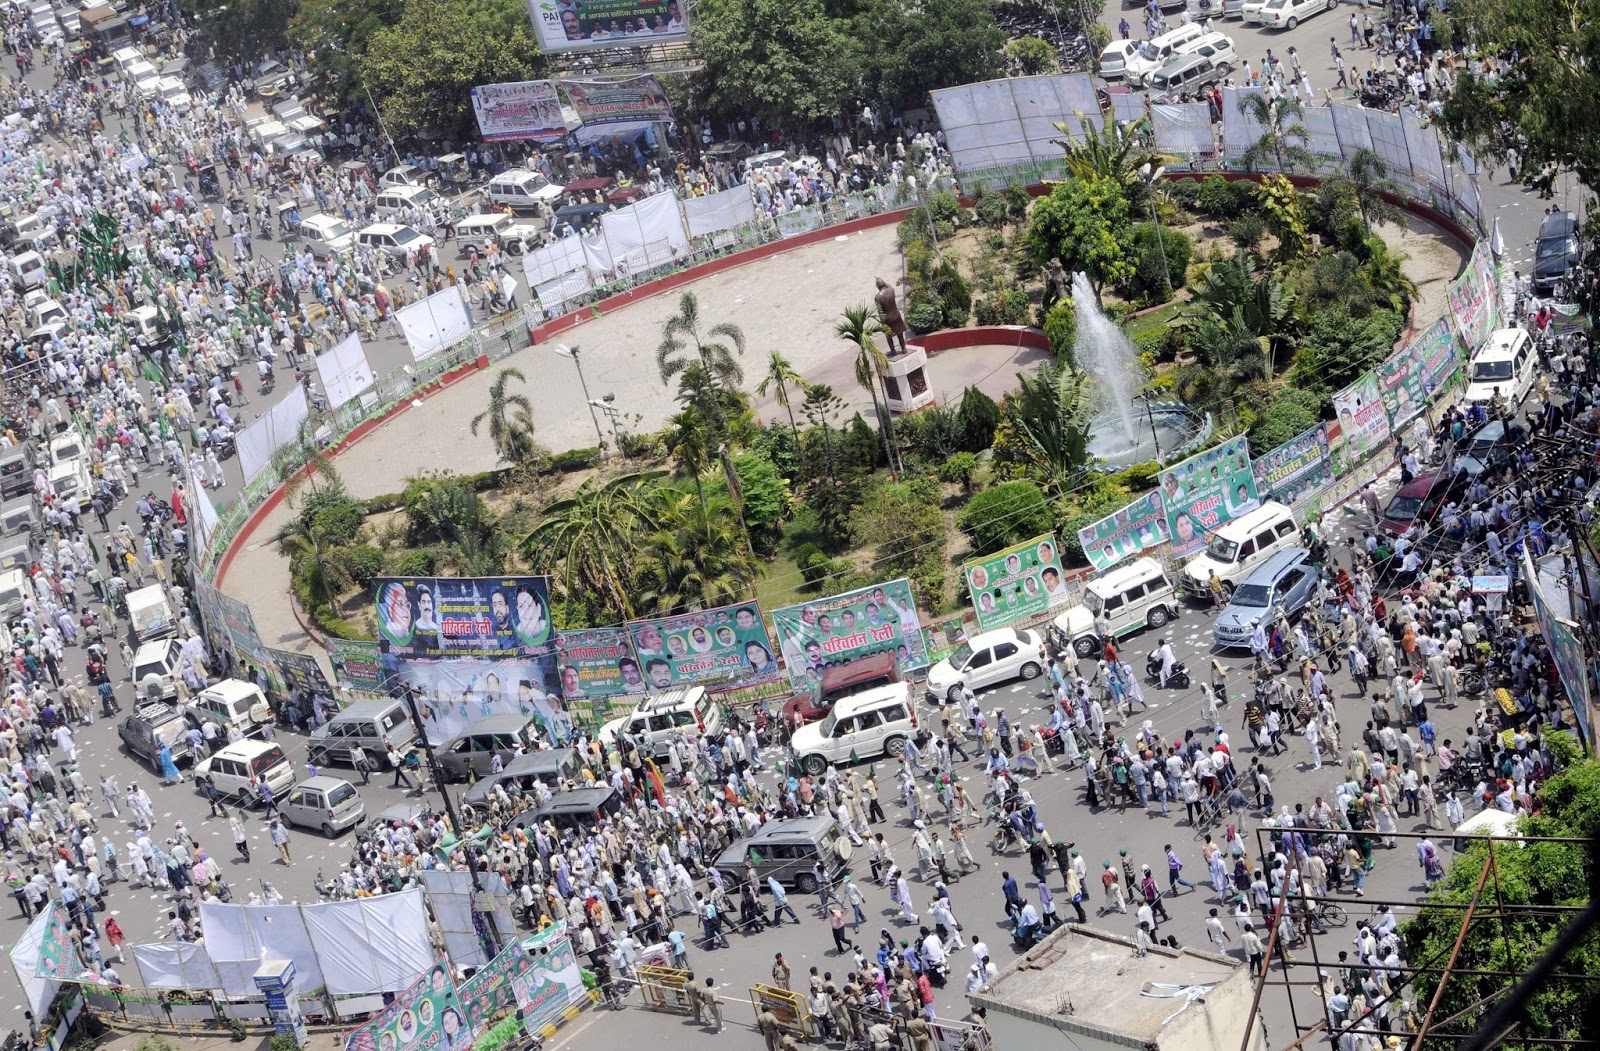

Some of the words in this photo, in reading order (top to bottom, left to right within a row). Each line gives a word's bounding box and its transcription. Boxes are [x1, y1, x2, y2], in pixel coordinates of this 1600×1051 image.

[1267, 458, 1303, 483] परिवर्तन
[1303, 445, 1321, 462] रैली
[1190, 494, 1223, 516] परिवर्तन
[1089, 527, 1126, 552] परिवर्तन
[440, 617, 473, 635] परिवर्तन
[472, 616, 493, 635] रैली
[822, 631, 868, 653] परिवर्तन
[866, 623, 895, 641] रैली
[569, 644, 600, 659] परिवर्तन
[601, 642, 619, 657] रैली
[676, 660, 715, 673] परिवर्तन
[474, 972, 500, 996] परिवर्तन
[523, 994, 545, 1014] परिवर्तन
